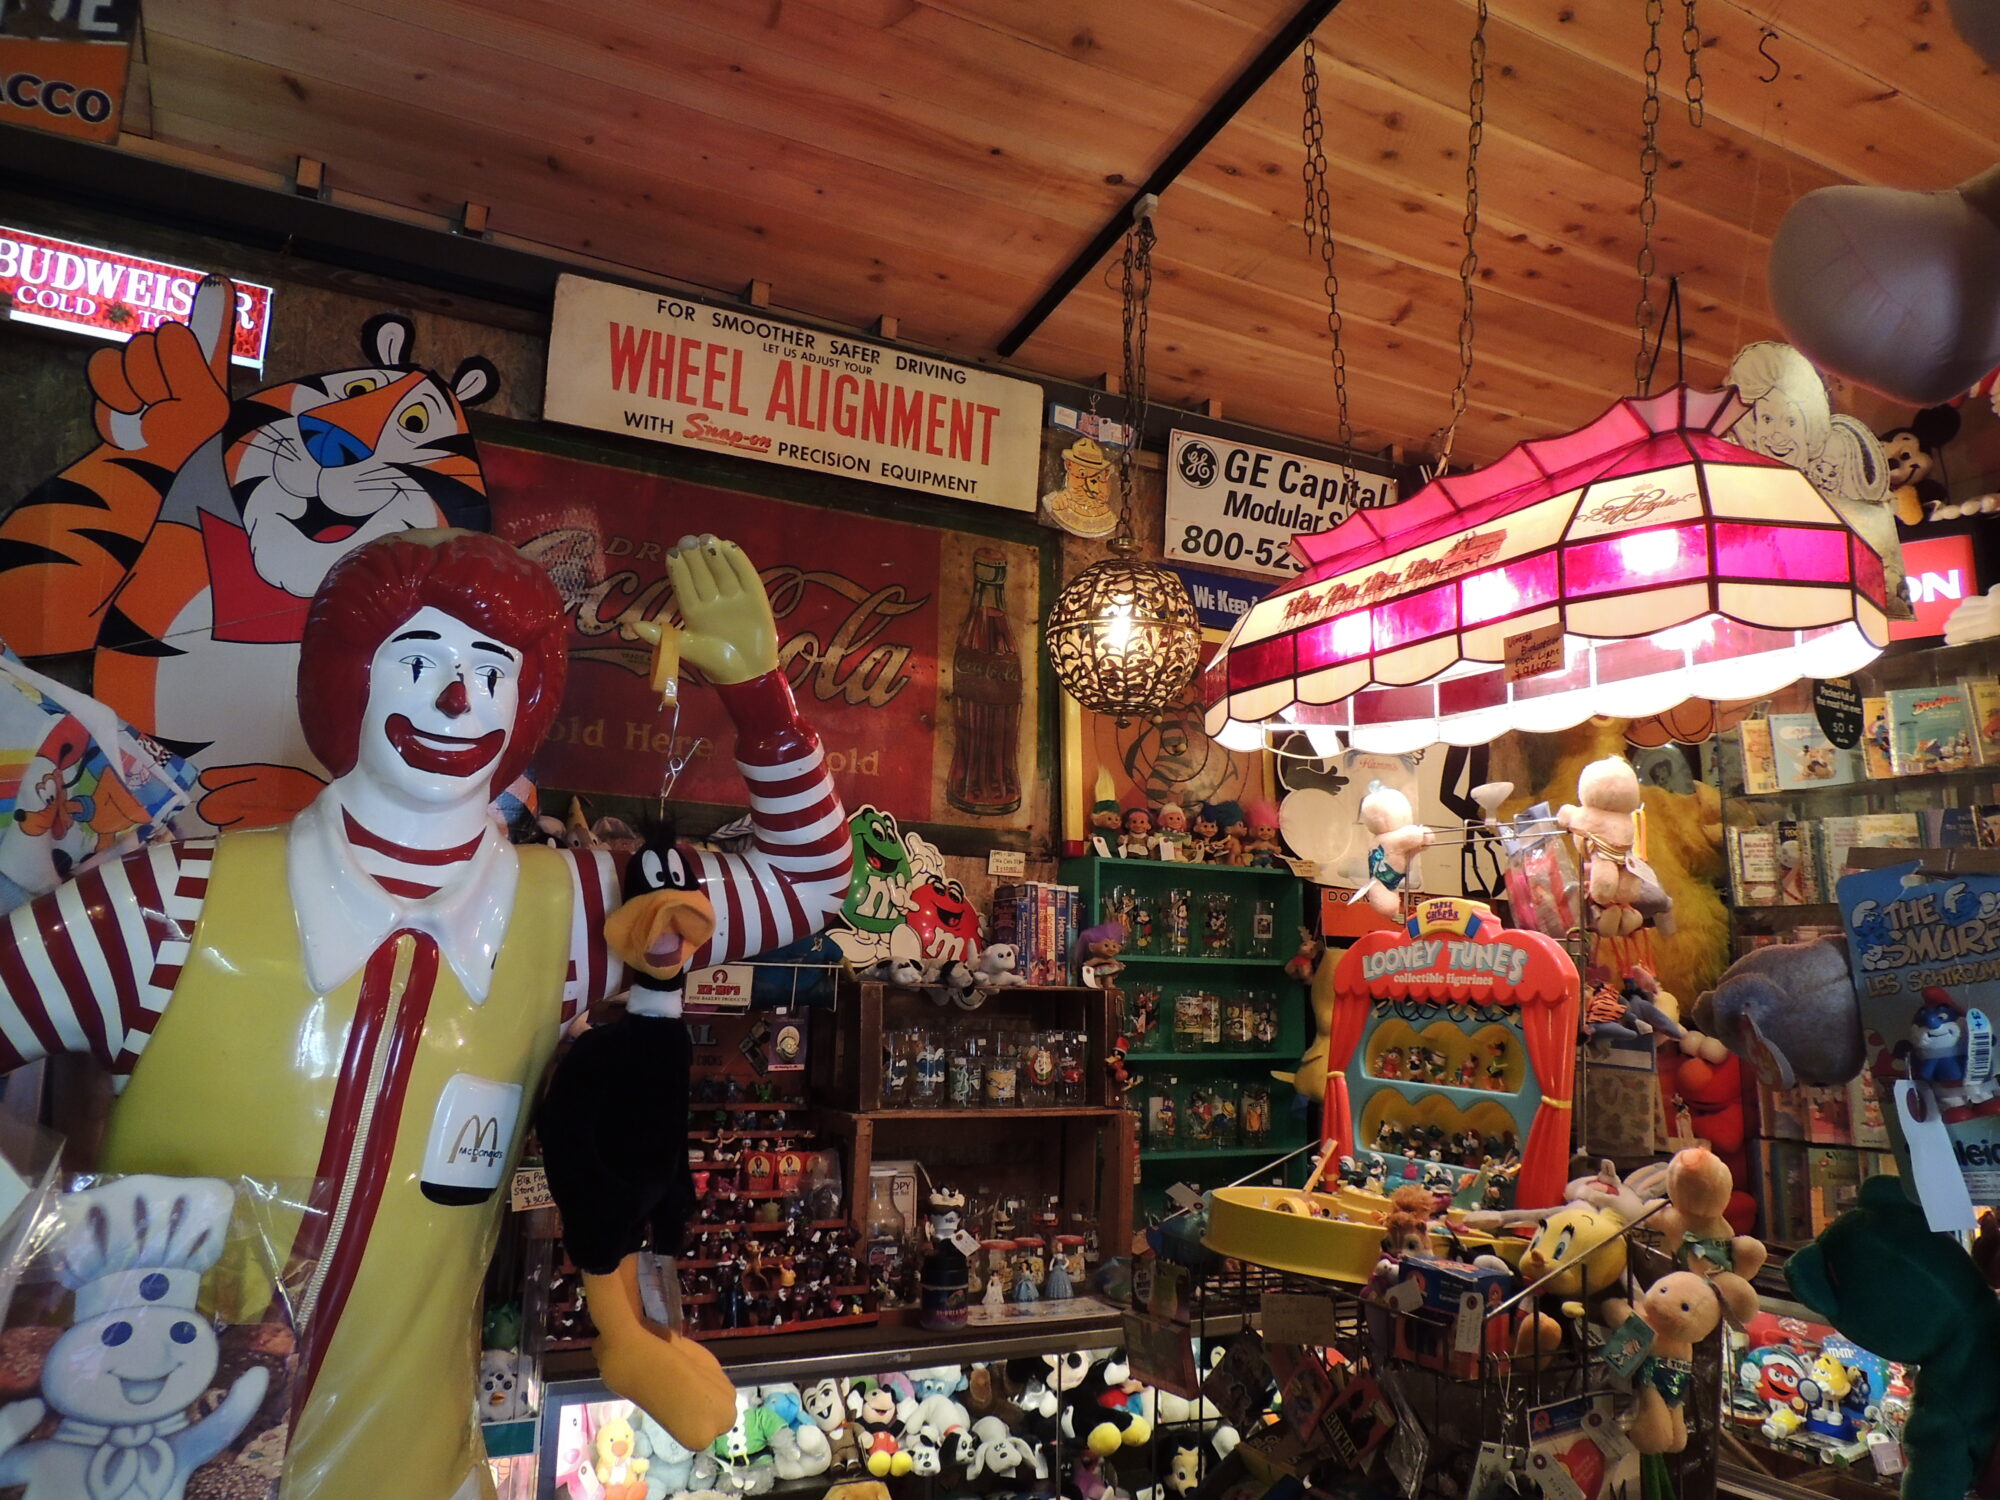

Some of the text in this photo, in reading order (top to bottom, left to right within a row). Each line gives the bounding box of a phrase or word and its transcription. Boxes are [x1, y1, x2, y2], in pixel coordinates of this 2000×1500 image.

[0, 73, 112, 124] CCO
[0, 237, 255, 330] BUDWEISR
[17, 285, 97, 316] COLD
[657, 299, 967, 385] FOR SMOOTHER SAFER DRIVING
[762, 342, 873, 376] LET US ADJUST YOUR
[608, 321, 1001, 467] WHEEL ALIGNMENT
[624, 410, 978, 495] WITH Snap-on PRECISION EQUIPMENT
[1224, 449, 1388, 510] GE Capital
[1223, 490, 1323, 533] Modular
[543, 715, 715, 758] old Here
[825, 748, 879, 777] old
[1882, 893, 1941, 930] THE
[1362, 940, 1529, 985] LOONEY TUNES
[1394, 972, 1494, 986] collectible figurines
[1865, 973, 1902, 997] LES
